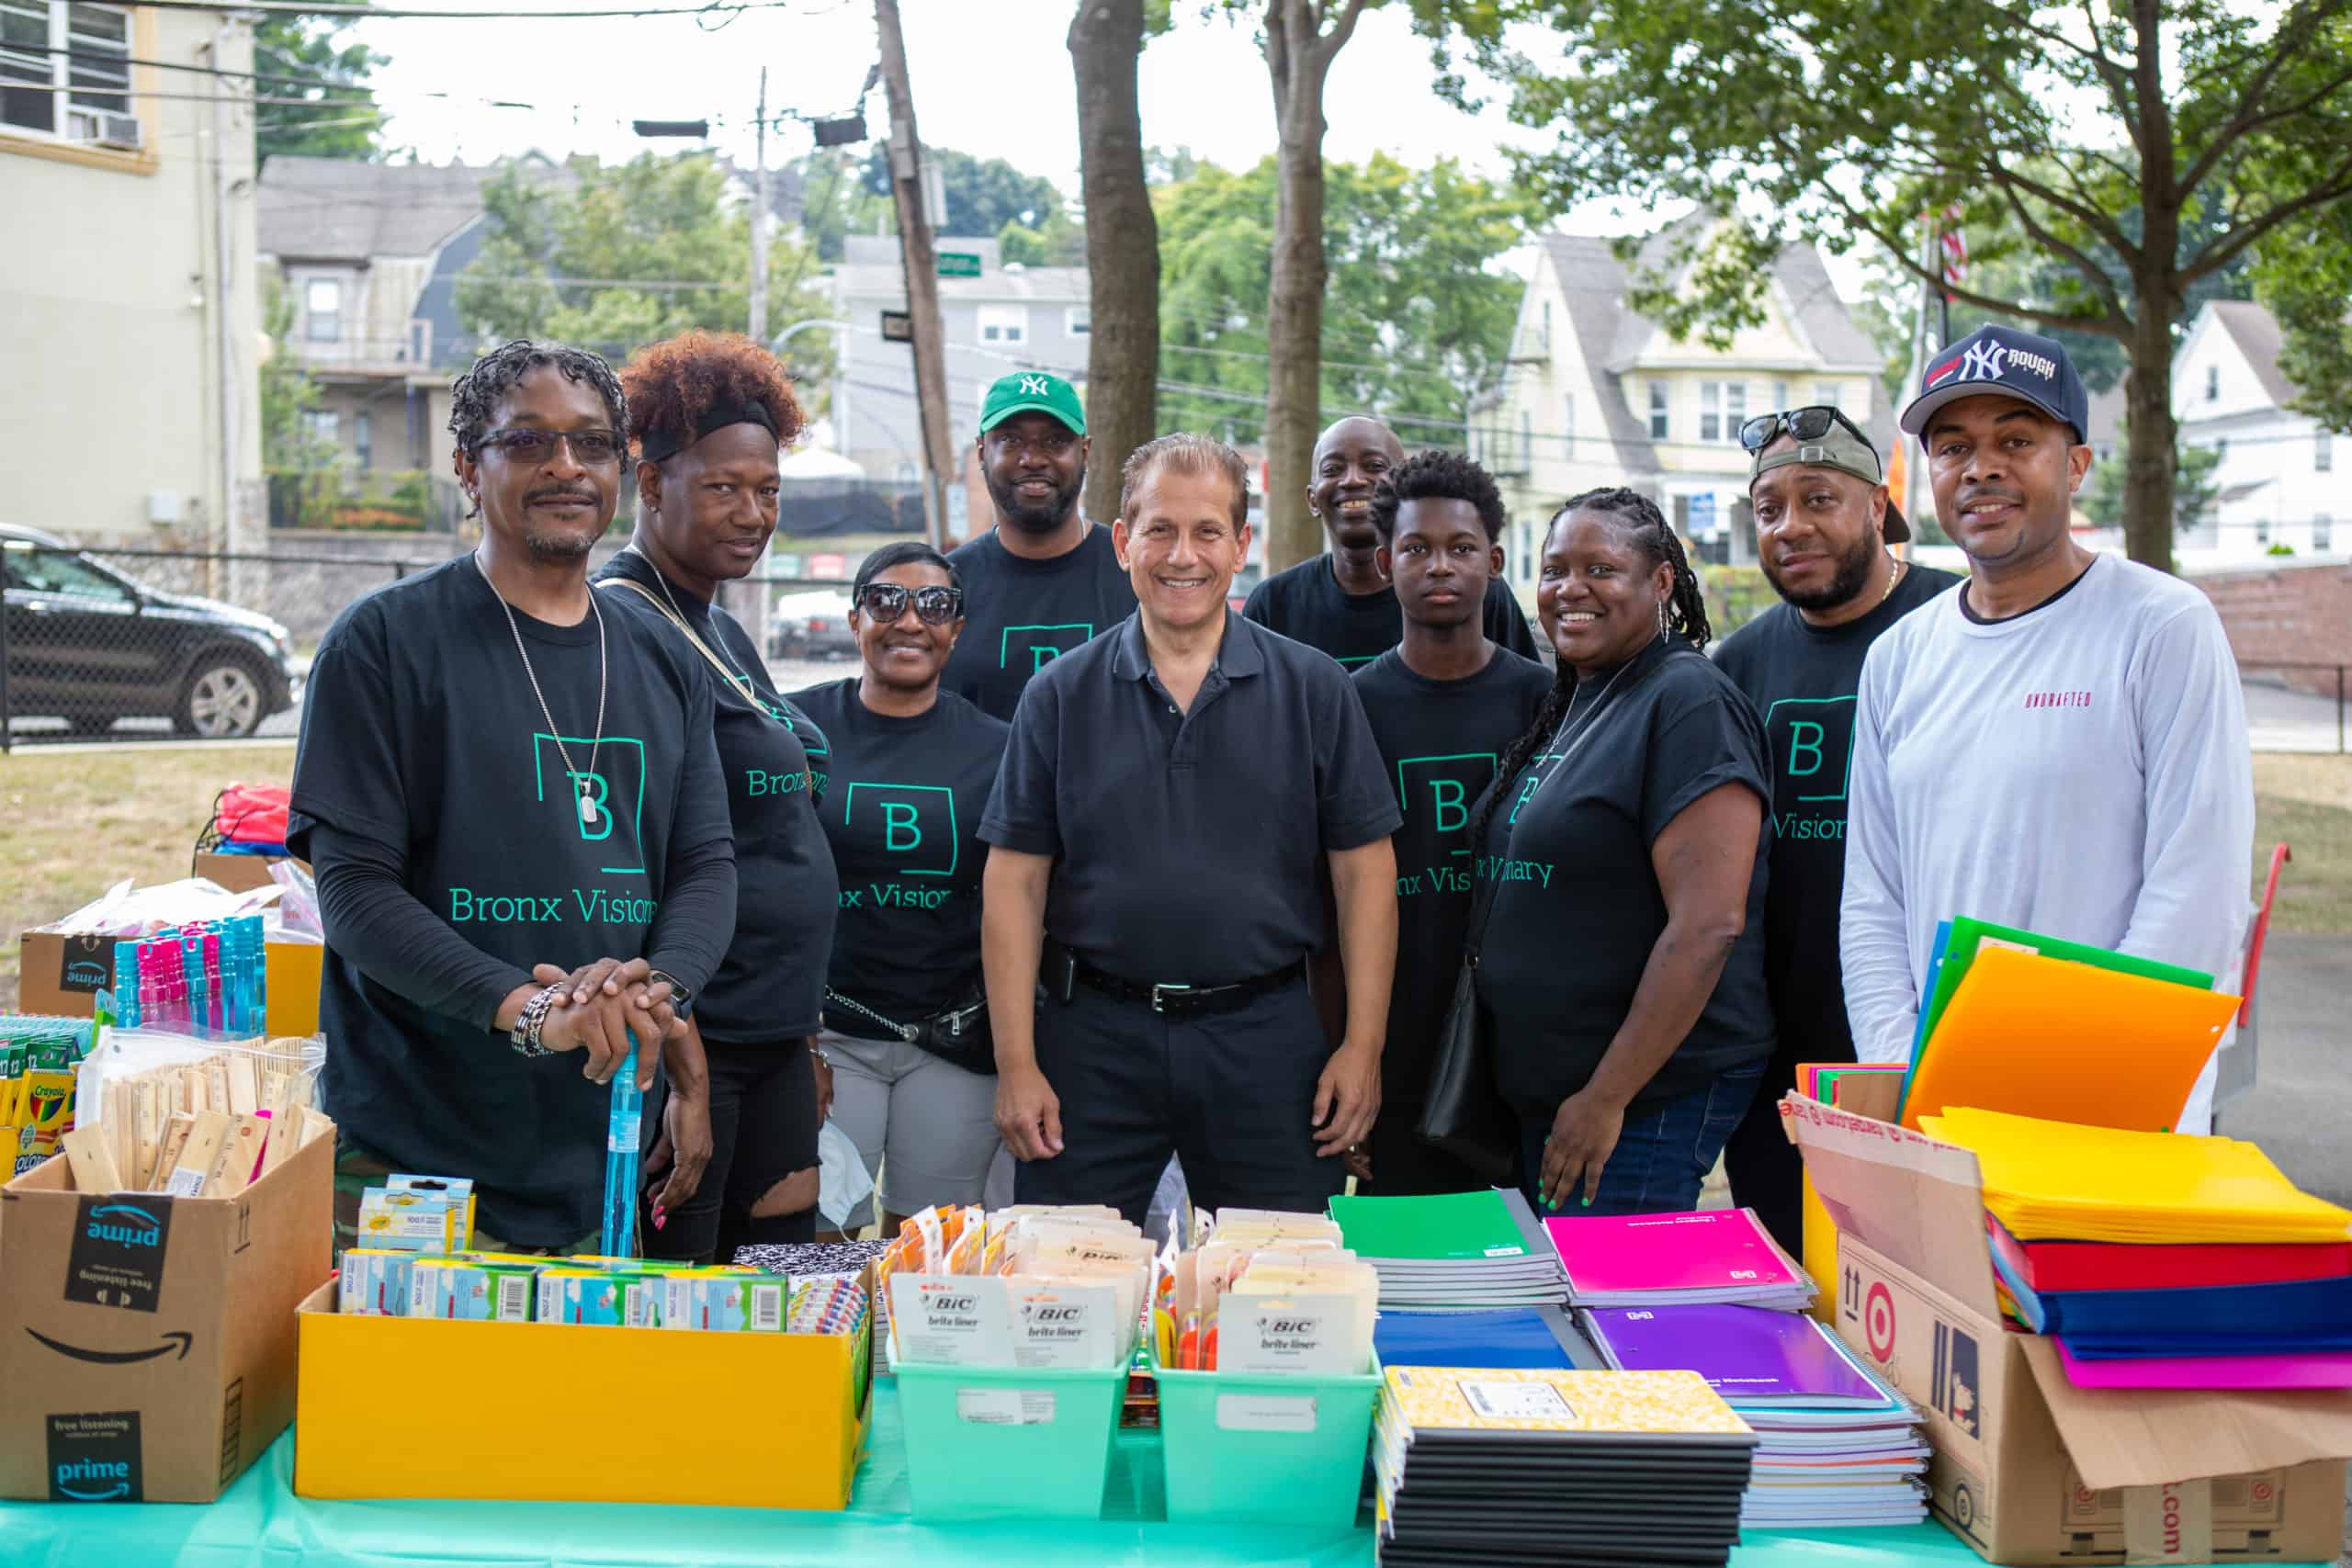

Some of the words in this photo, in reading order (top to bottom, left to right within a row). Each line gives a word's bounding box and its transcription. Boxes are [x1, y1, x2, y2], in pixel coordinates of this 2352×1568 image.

[2007, 348, 2056, 381] ROUGH
[1019, 374, 1048, 397] NY
[1789, 721, 1824, 775] B
[566, 770, 613, 840] B
[1429, 779, 1469, 831] B
[880, 801, 922, 851] B
[449, 887, 563, 922] Bronx
[67, 972, 107, 986] prime
[35, 1085, 65, 1100] Crayola
[87, 1222, 160, 1248] prime
[58, 1457, 129, 1485] prime
